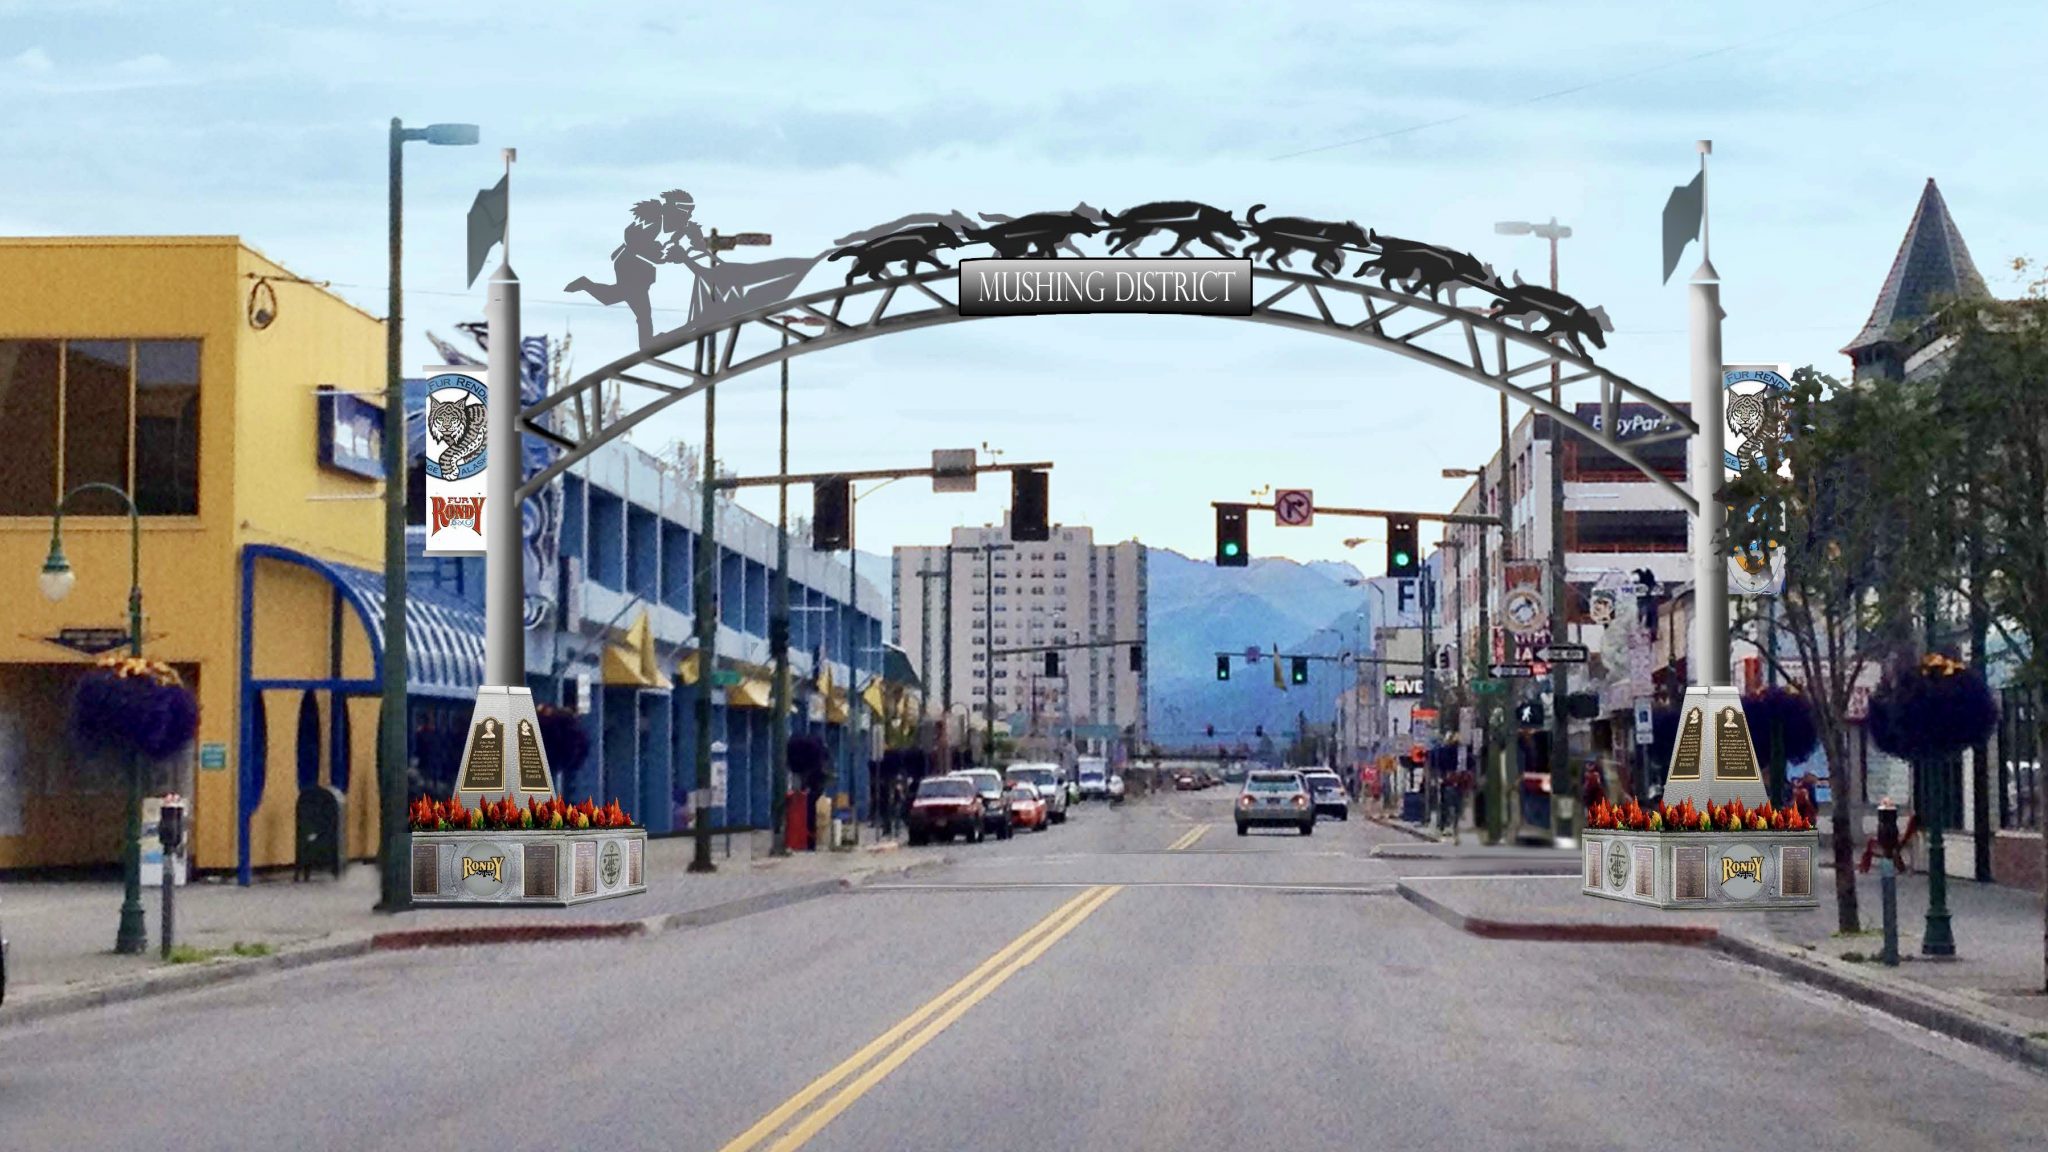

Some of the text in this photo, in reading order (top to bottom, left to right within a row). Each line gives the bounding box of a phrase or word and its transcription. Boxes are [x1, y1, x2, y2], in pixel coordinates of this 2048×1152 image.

[979, 270, 1237, 303] MUSHING DISTRICT
[428, 379, 452, 390] FUR
[1726, 371, 1750, 383] FUR
[1592, 415, 1670, 436] EsyPar
[447, 496, 470, 504] FUR
[429, 496, 487, 537] RONDY
[462, 856, 505, 883] RONDY
[1720, 856, 1765, 885] RONDY
